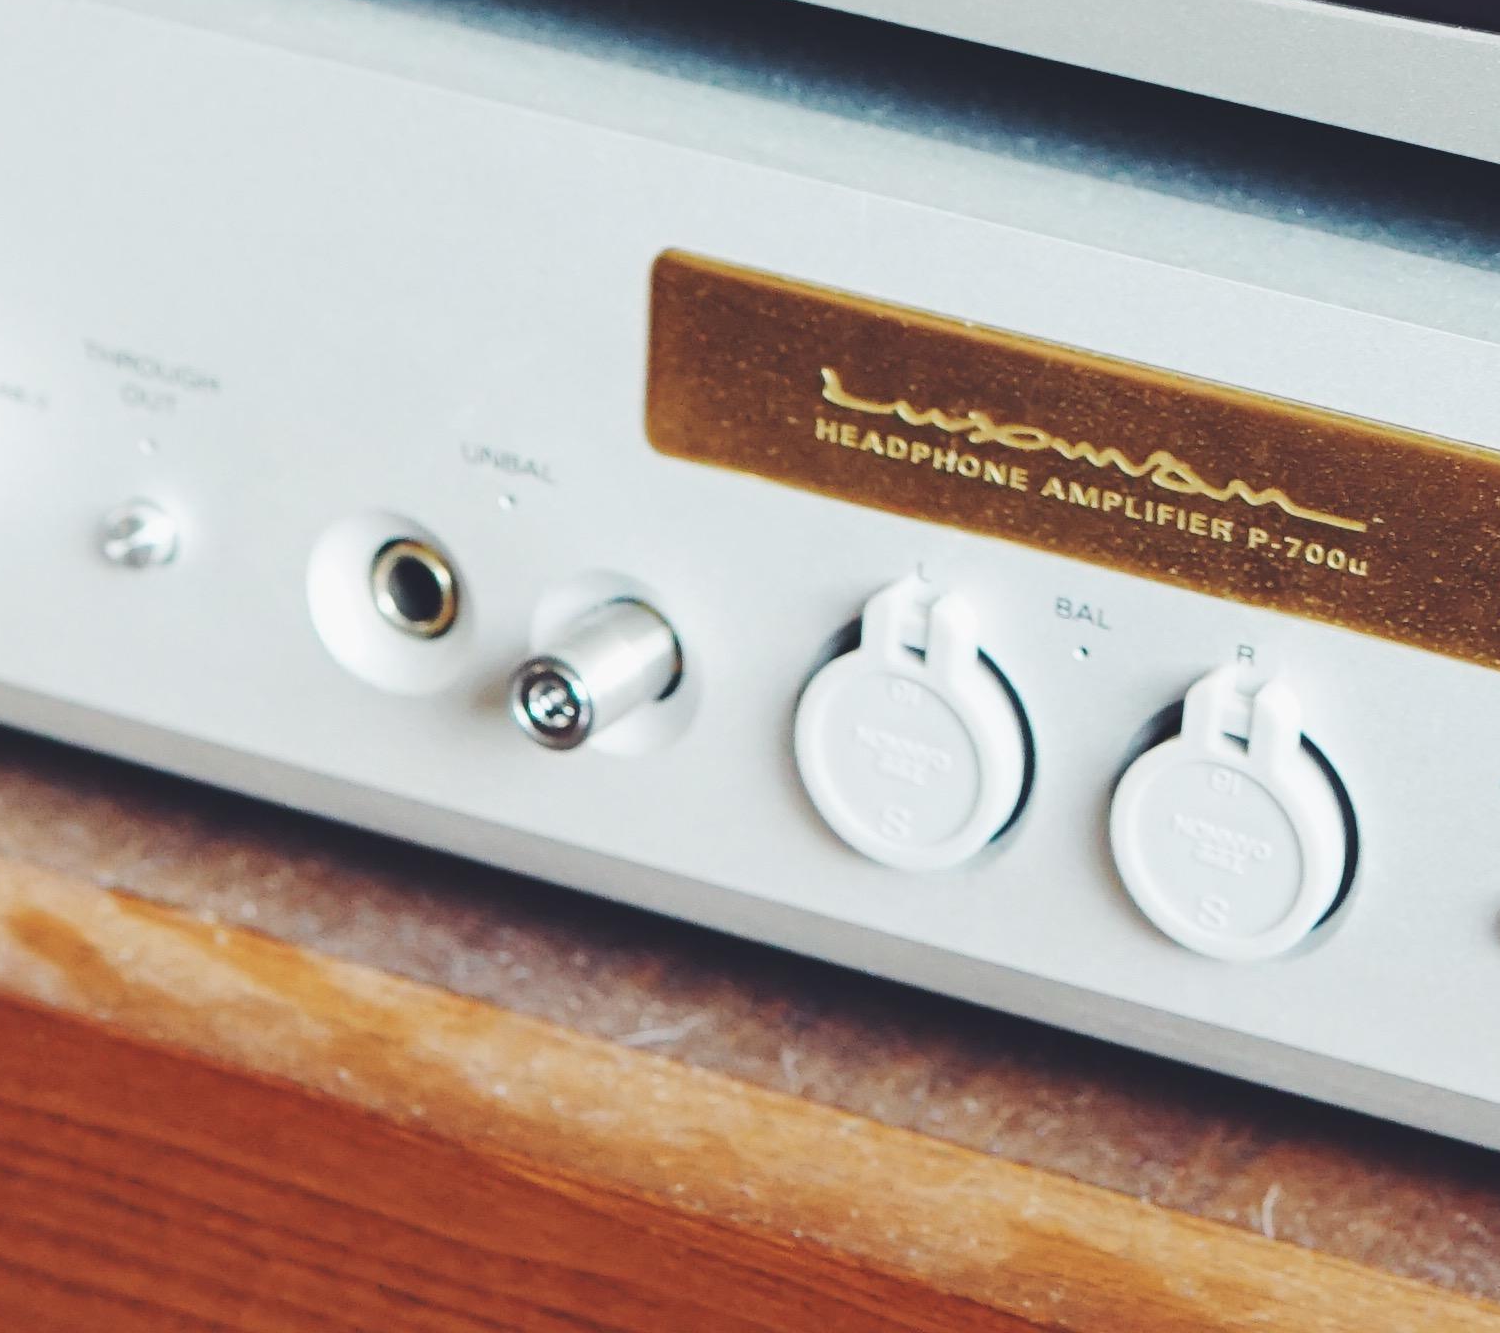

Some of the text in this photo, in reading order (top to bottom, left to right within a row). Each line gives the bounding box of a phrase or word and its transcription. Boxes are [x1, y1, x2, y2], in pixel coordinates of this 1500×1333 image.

[814, 417, 1369, 577] HEADPHONE AMPLIFIER P-700u
[1055, 596, 1112, 631] BAL
[1236, 644, 1255, 666] R
